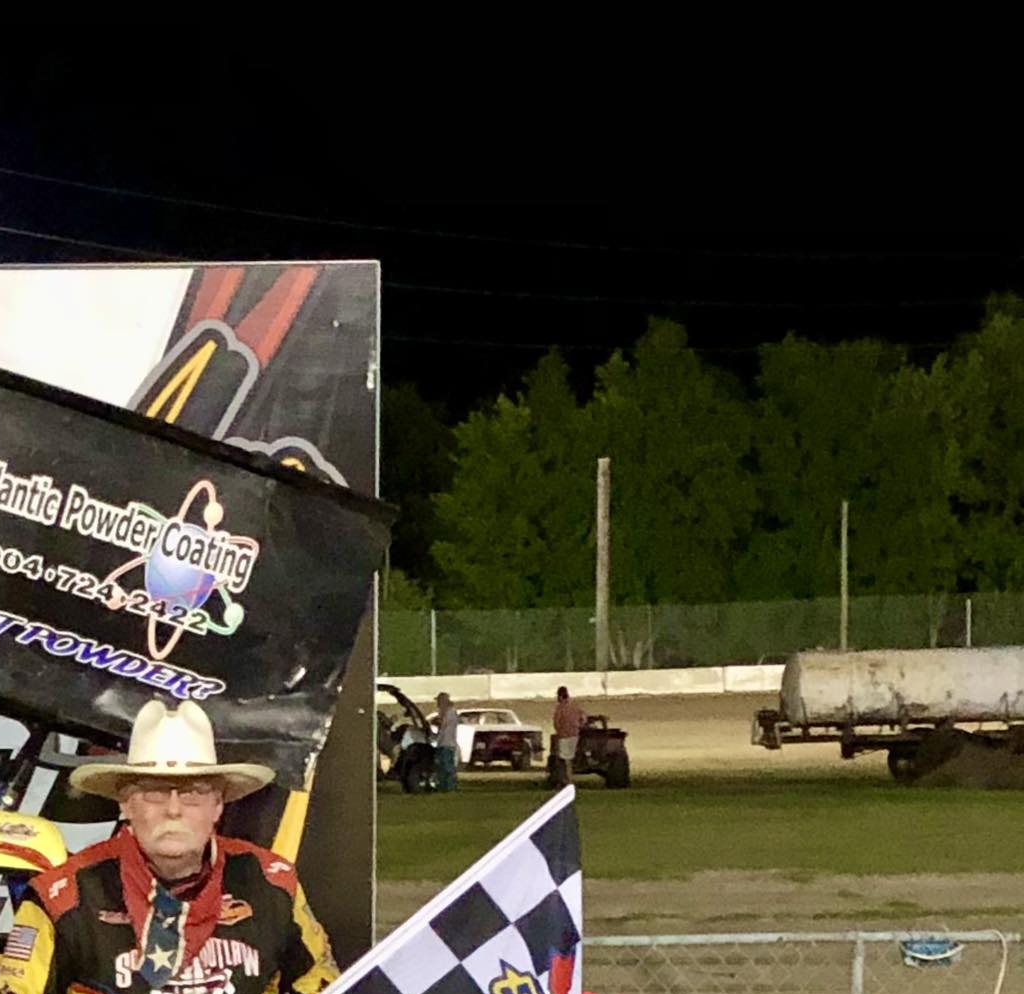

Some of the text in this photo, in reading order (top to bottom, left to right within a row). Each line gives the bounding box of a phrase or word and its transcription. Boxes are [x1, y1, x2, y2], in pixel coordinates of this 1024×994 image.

[60, 484, 160, 553] Powder
[160, 515, 257, 593] Coating
[15, 621, 226, 700] POWDER?
